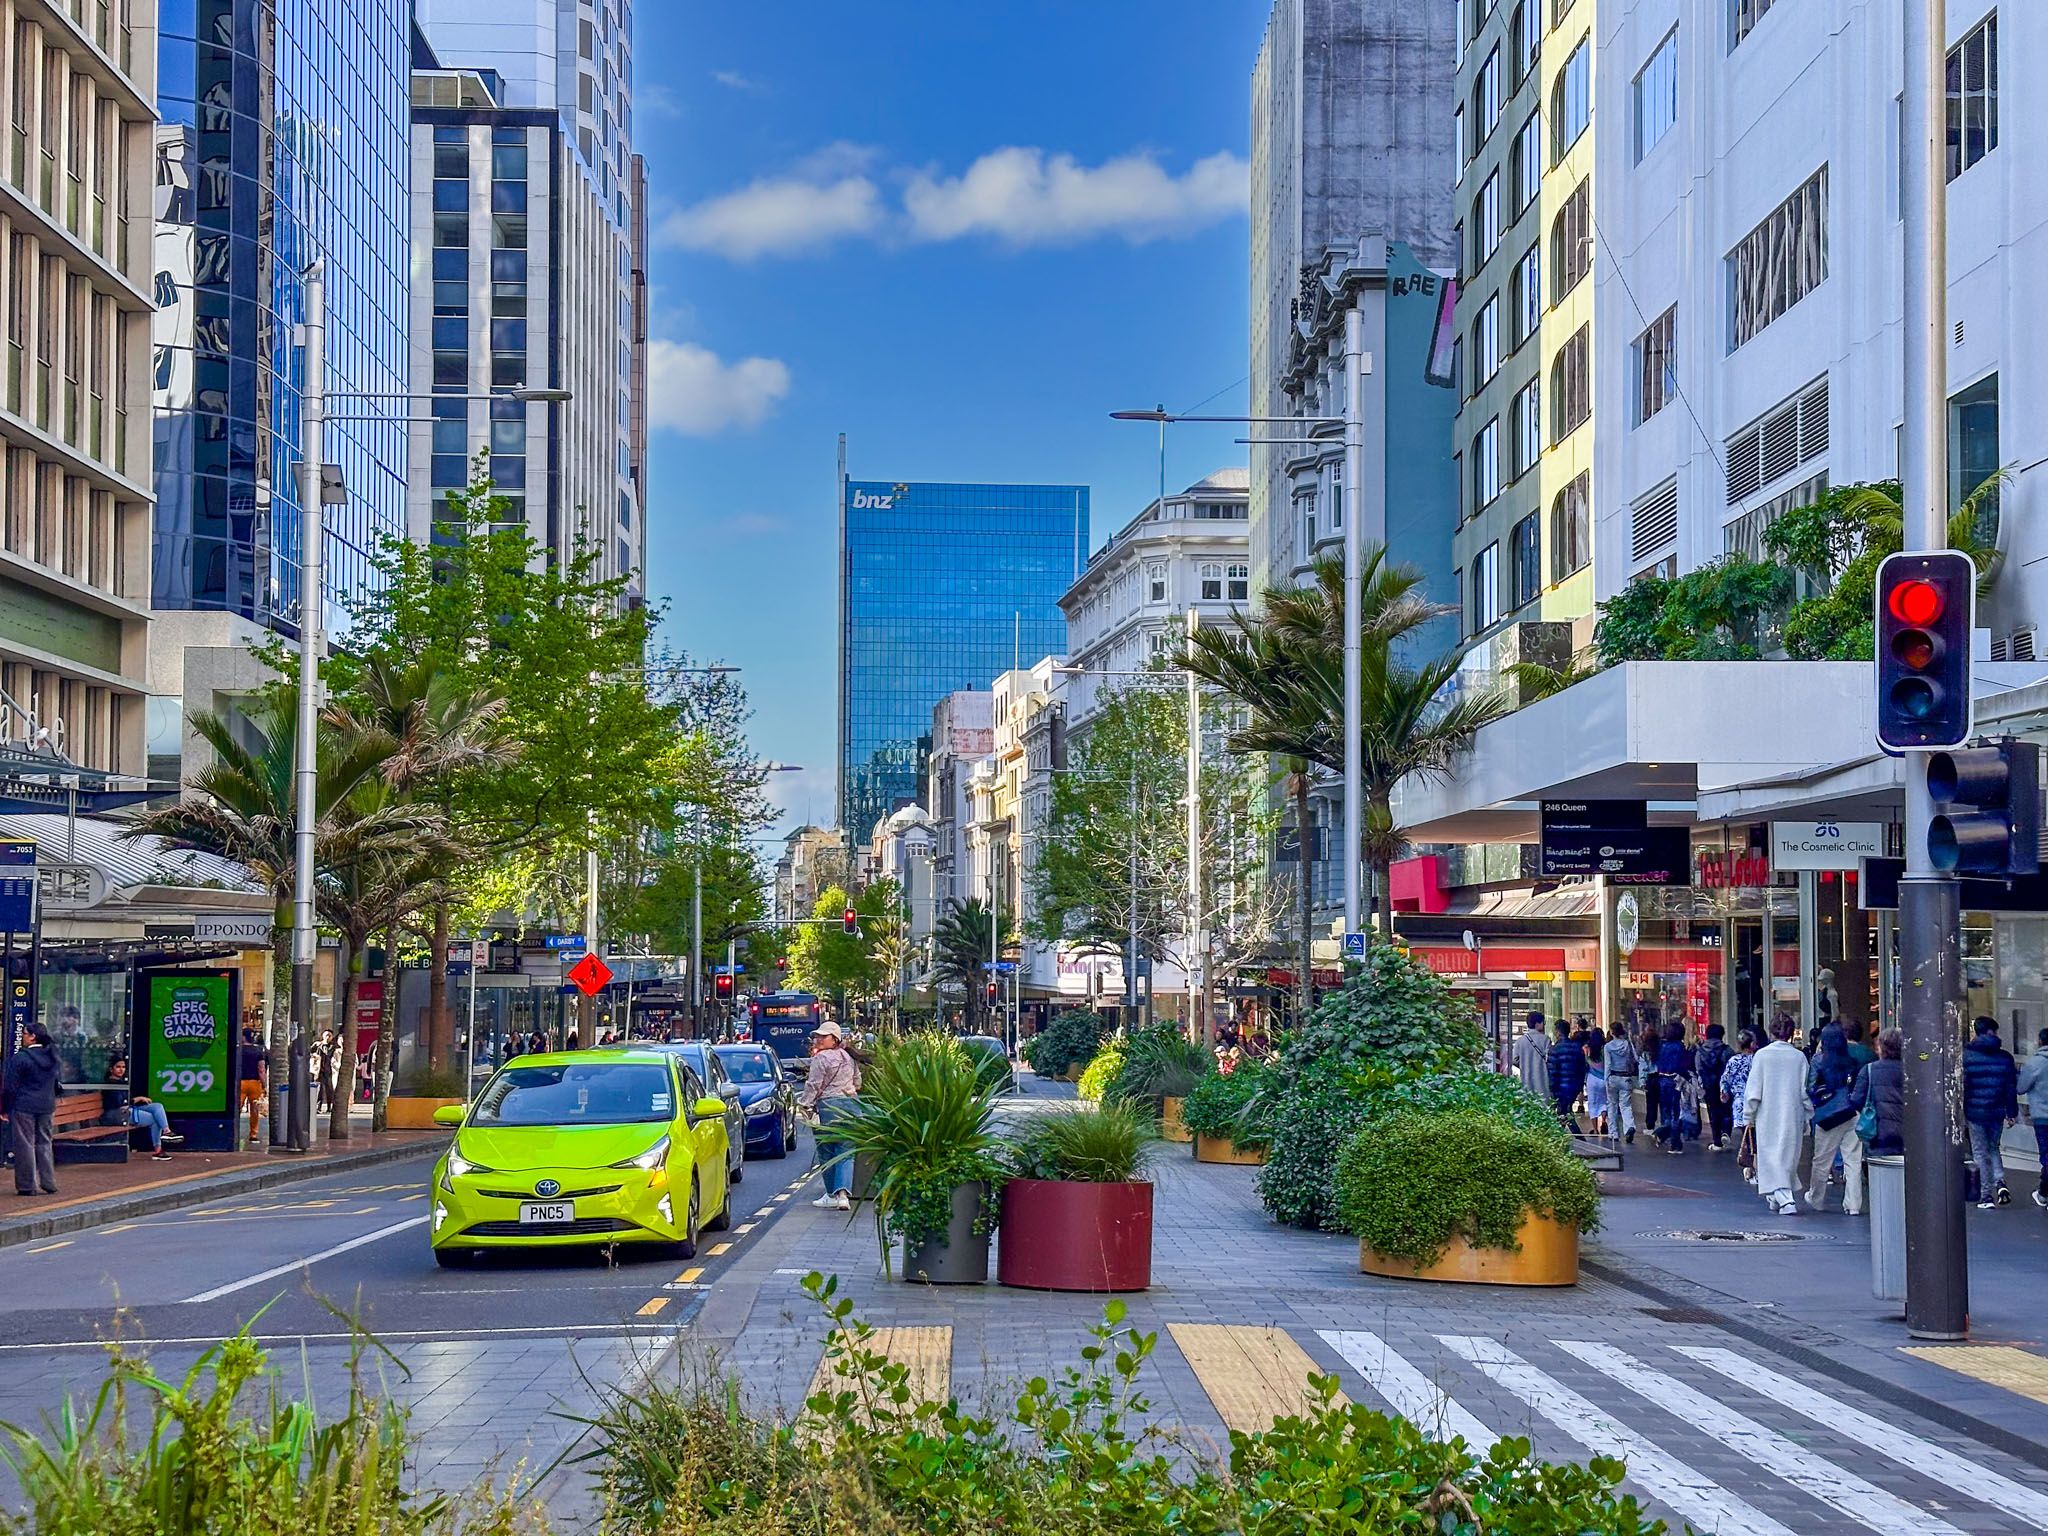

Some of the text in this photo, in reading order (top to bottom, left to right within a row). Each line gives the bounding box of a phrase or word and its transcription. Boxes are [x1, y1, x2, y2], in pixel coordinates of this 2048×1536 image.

[1393, 273, 1435, 297] RAE
[853, 489, 893, 509] bnz
[1545, 803, 1587, 812] 246 Queen
[1781, 841, 1875, 852] The Cosmetic Clinic
[198, 924, 267, 936] IPPONDO
[396, 958, 419, 968] THE
[172, 1001, 209, 1013] SPEC
[15, 1013, 24, 1021] St
[163, 1013, 215, 1027] STRAVA
[164, 1025, 215, 1039] GANZA
[779, 1027, 803, 1035] Metro
[157, 1070, 214, 1093] $299
[530, 1206, 564, 1220] PNC5
